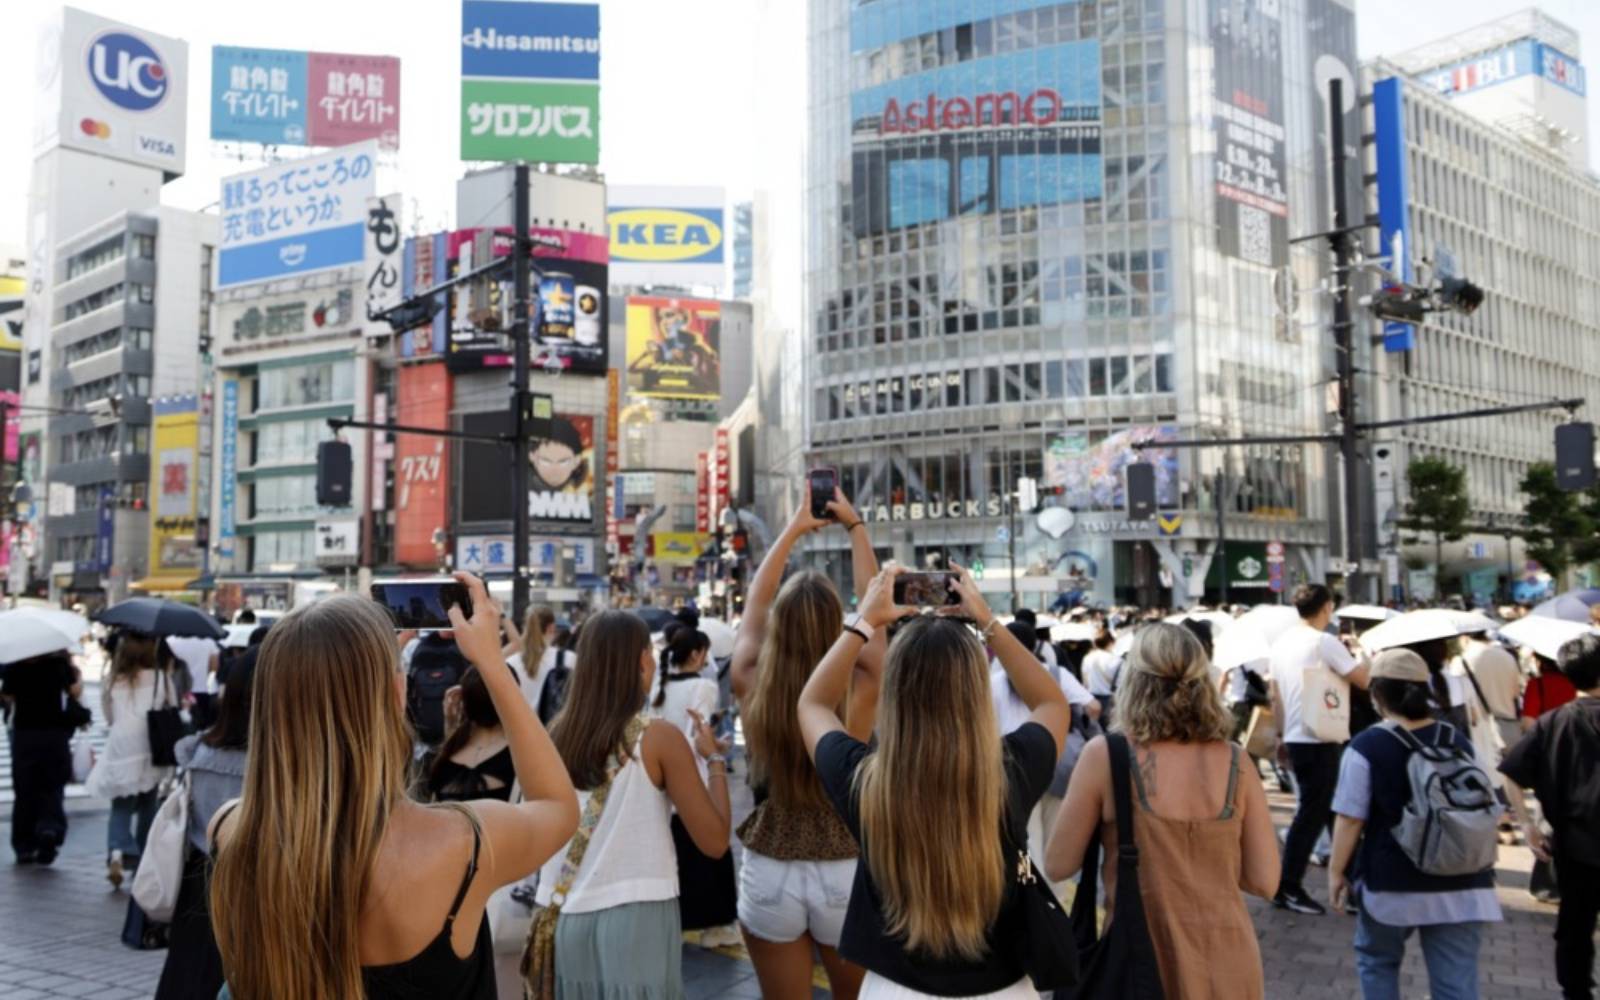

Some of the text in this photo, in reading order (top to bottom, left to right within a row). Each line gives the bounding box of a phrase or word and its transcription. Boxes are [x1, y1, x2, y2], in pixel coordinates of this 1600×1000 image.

[467, 103, 593, 139] サロンパス
[879, 88, 1063, 136] Astemo
[139, 136, 176, 156] VISA
[224, 154, 372, 210] 観るってこころの
[607, 223, 712, 247] KEA
[860, 500, 1001, 522] TARBUCKS
